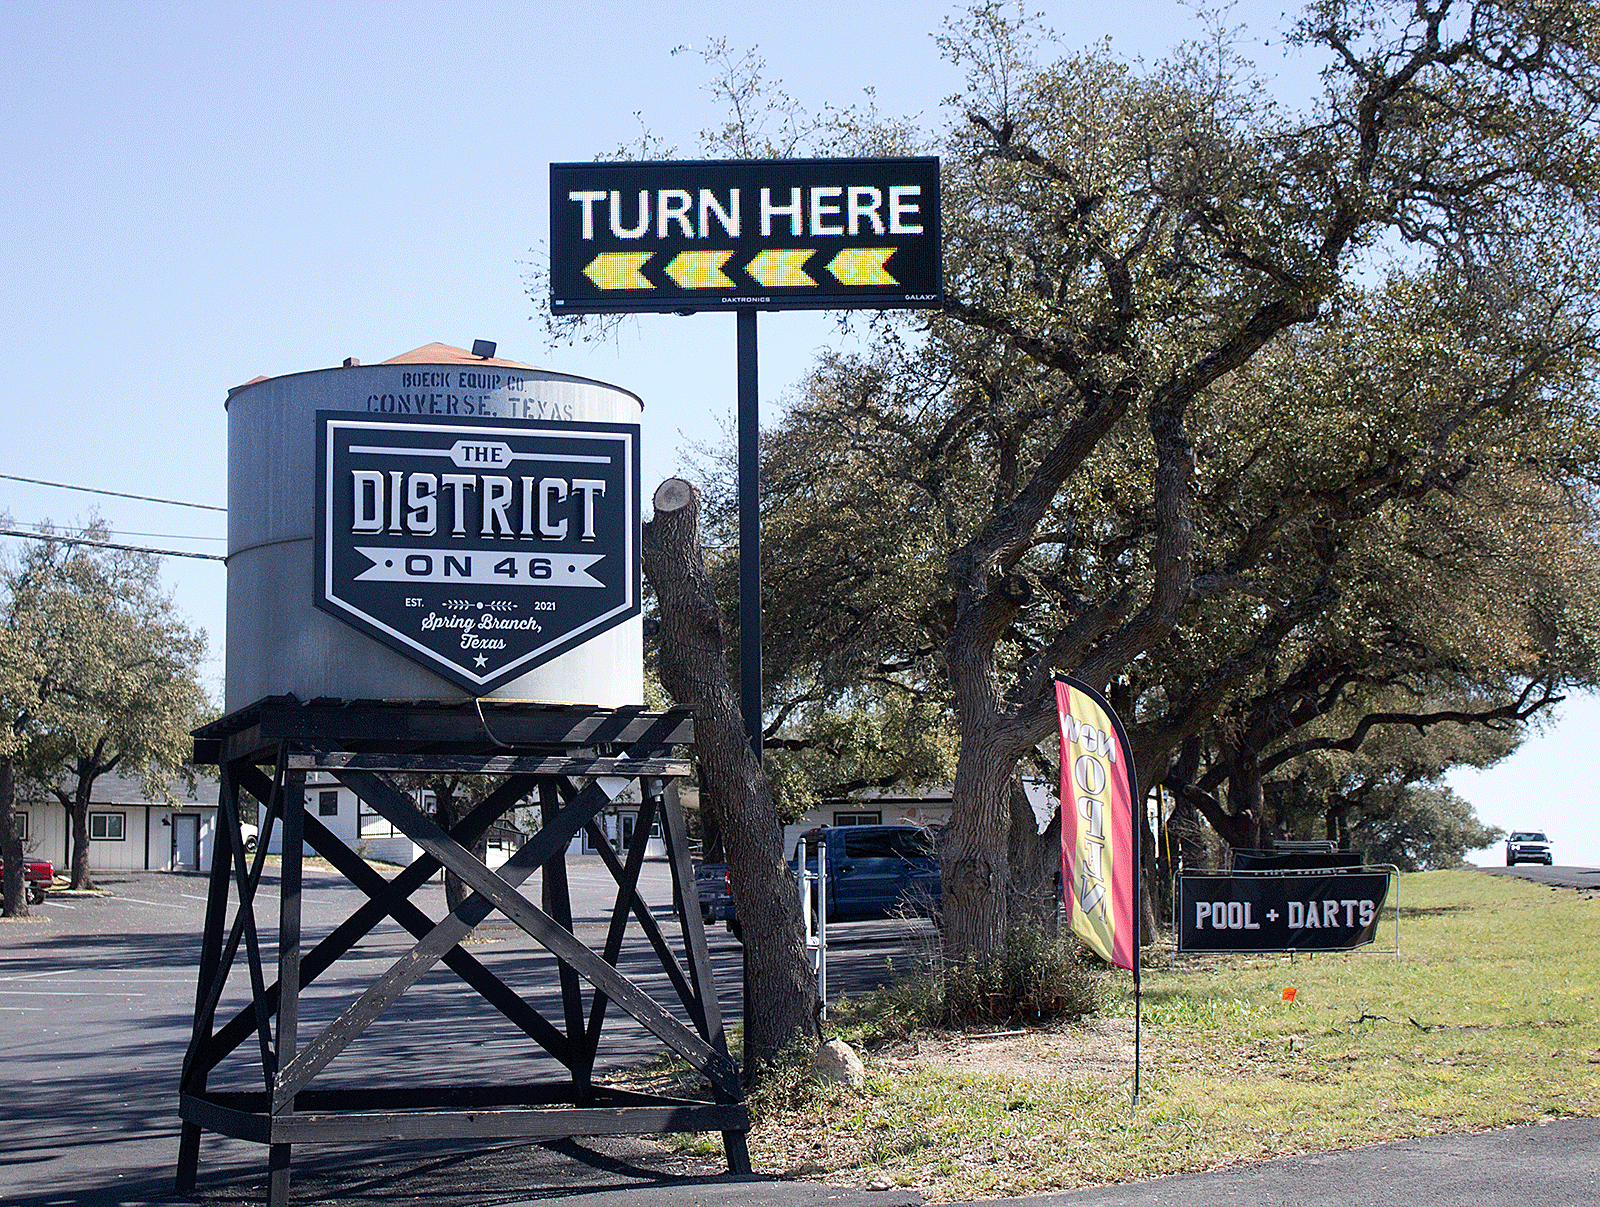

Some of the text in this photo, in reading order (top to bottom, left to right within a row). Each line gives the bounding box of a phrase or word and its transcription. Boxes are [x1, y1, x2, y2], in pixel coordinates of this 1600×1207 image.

[568, 185, 924, 240] TURN HERE
[402, 372, 527, 393] BOECK EQUIP. CO.
[508, 397, 573, 422] TEXAS
[461, 446, 504, 463] THE
[351, 470, 606, 543] DISTRICT
[404, 554, 552, 579] ON 46
[405, 598, 556, 611] EST. 2021
[421, 611, 542, 633] Spring Branch,
[459, 633, 507, 650] Texas
[1195, 900, 1375, 930] POOL + DARTS
